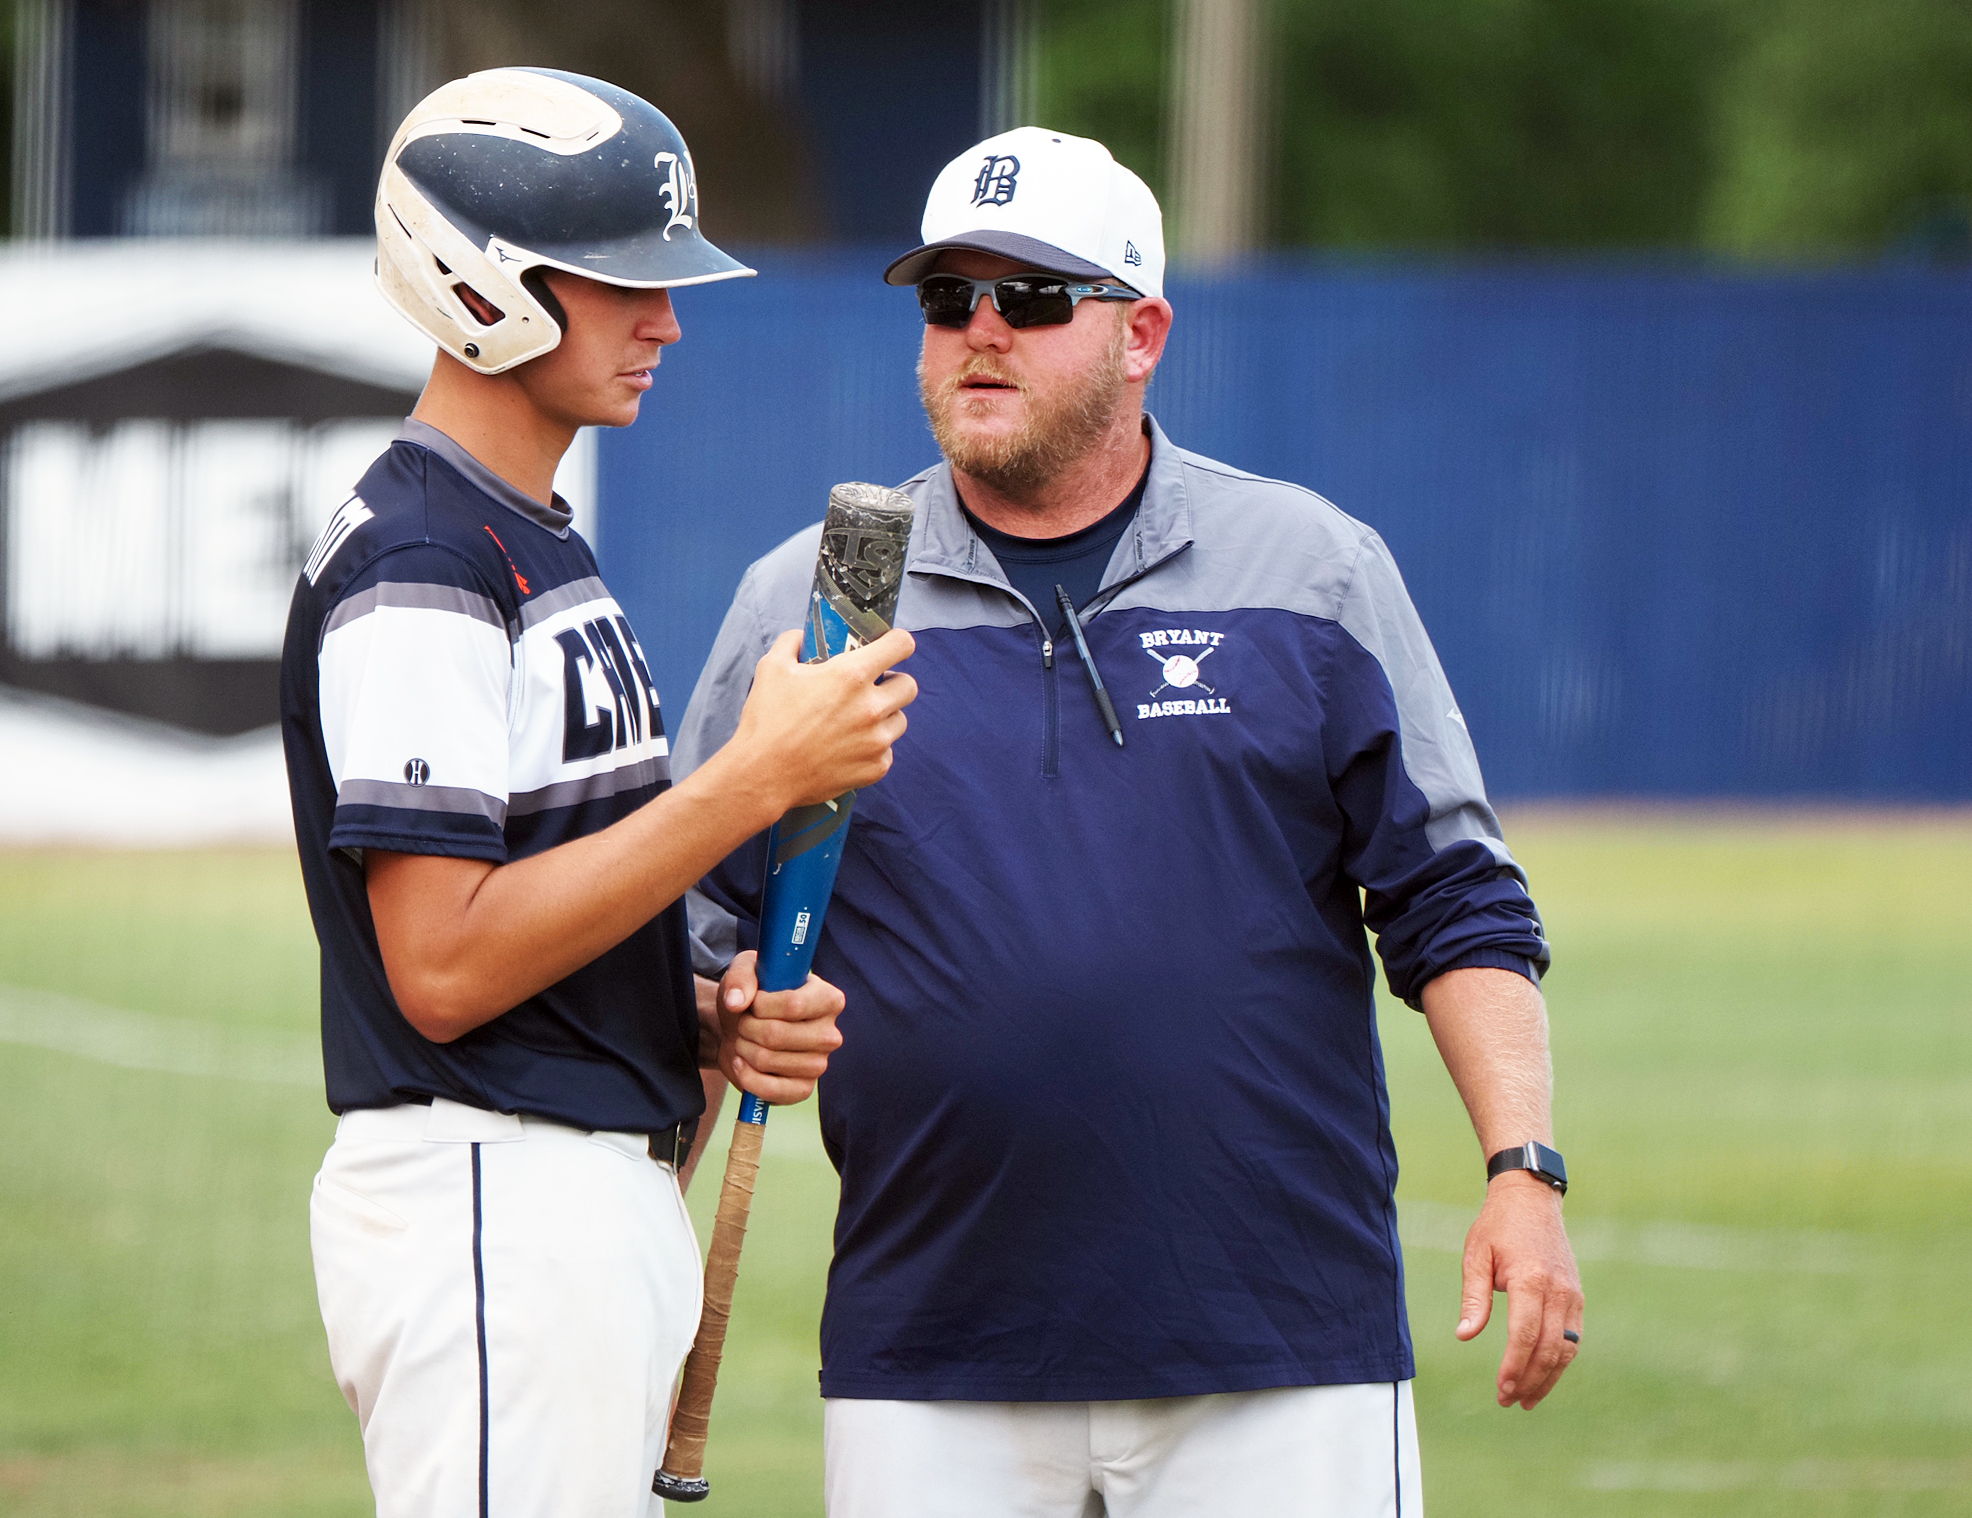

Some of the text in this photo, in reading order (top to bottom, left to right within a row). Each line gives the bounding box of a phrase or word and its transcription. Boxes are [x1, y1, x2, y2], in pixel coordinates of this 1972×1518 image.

[970, 154, 1021, 208] B
[1139, 629, 1224, 648] BRYANT
[1137, 698, 1231, 719] BASEBALL
